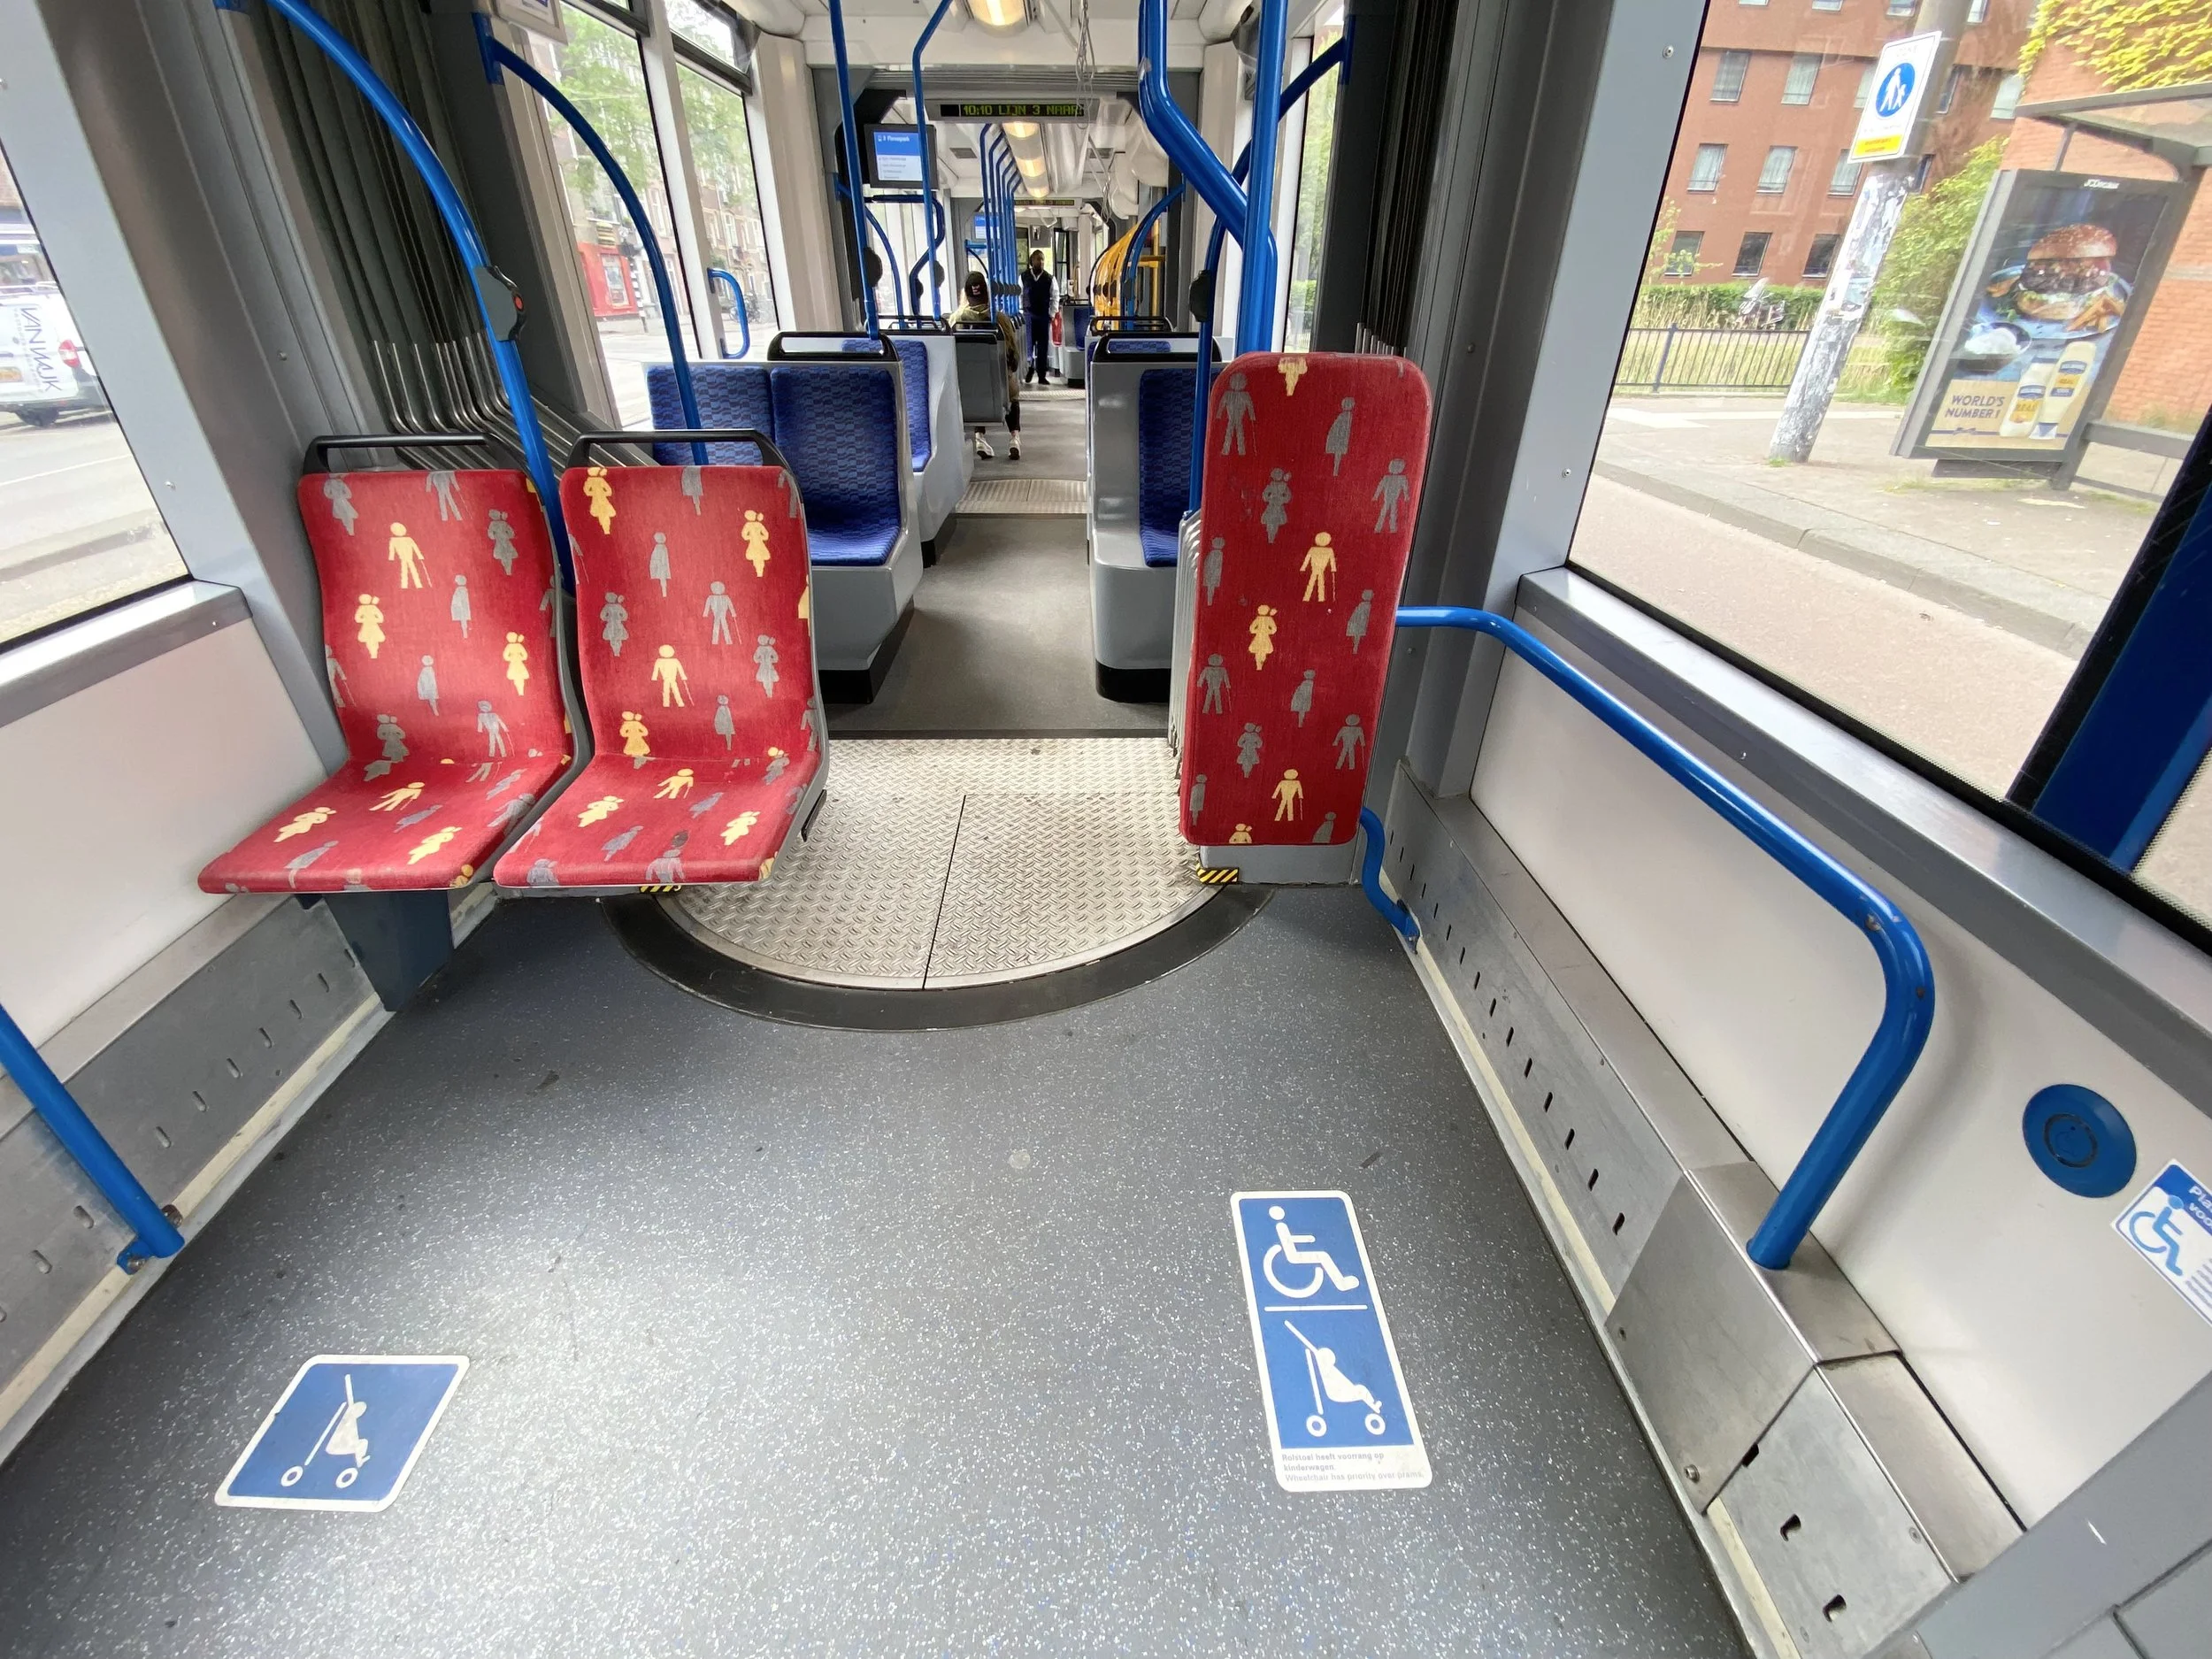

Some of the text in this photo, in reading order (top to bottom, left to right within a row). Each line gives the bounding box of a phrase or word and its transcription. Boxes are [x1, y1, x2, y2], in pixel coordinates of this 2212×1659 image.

[964, 104, 993, 116] 10:10
[998, 104, 1026, 116] LIJN
[1033, 104, 1041, 115] 3
[1952, 395, 2005, 407] WORLD'S
[1945, 408, 1993, 419] NUMBER
[2188, 1186, 2212, 1213] Pla
[2189, 1202, 2212, 1228] voo
[1347, 1472, 1376, 1481] priority
